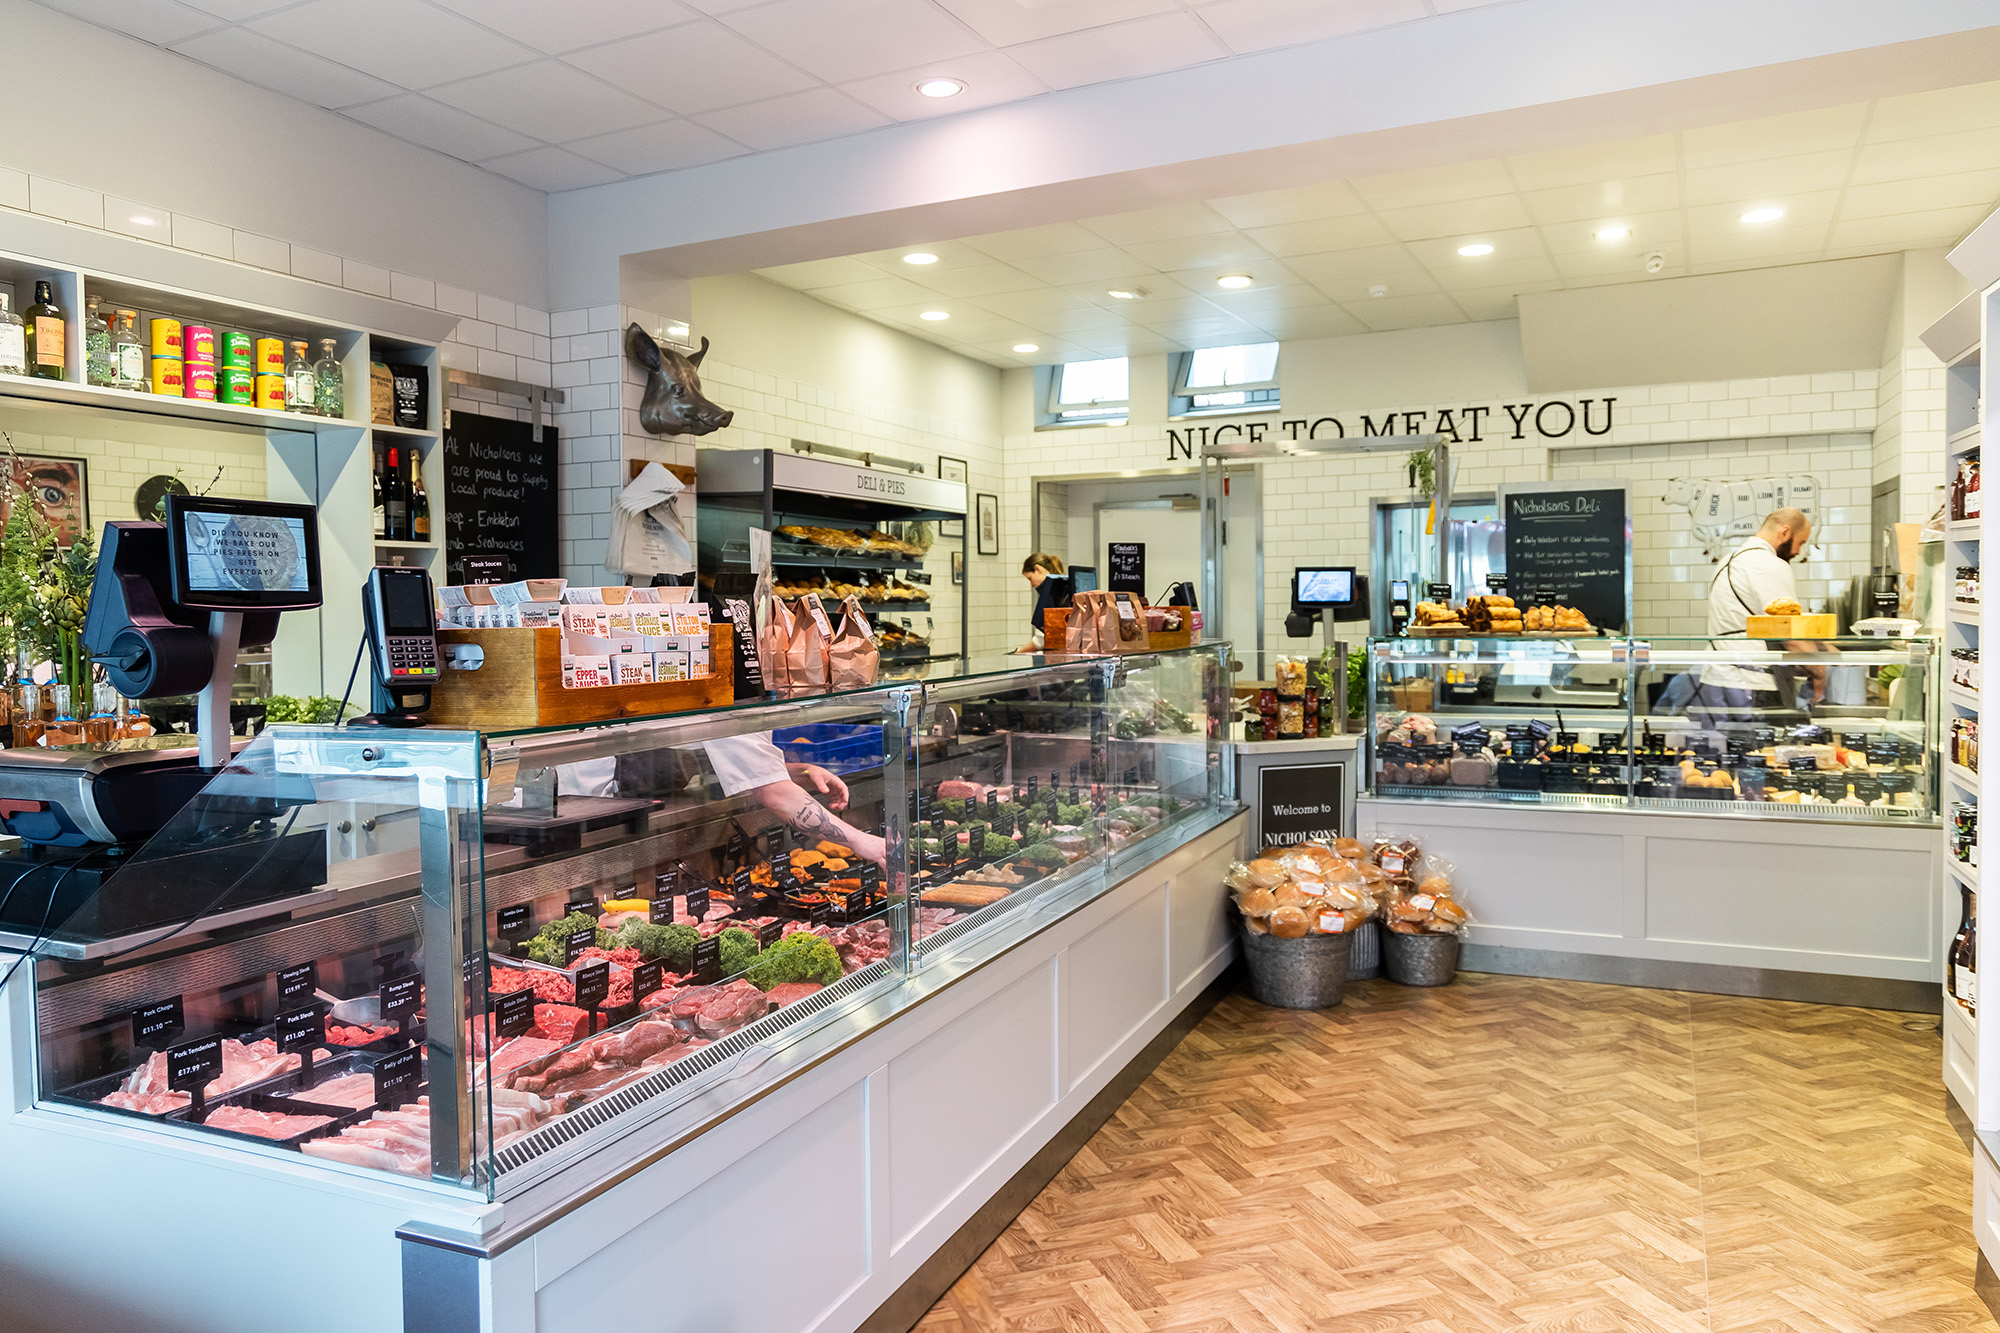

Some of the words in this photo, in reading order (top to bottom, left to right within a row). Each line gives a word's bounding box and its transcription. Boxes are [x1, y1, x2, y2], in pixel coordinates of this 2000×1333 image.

[1166, 422, 1268, 461] NICE
[1283, 417, 1344, 440] TO
[1360, 406, 1490, 443] MEAT
[1503, 398, 1617, 440] YOU
[445, 436, 460, 456] At
[469, 442, 522, 462] Nicholsons
[451, 464, 470, 477] are
[476, 468, 502, 482] proud
[506, 469, 518, 482] to
[857, 474, 877, 490] DELI
[879, 478, 886, 492] &
[888, 480, 905, 494] PIES
[484, 486, 525, 502] produce!
[1512, 499, 1570, 515] Nicholsons
[1575, 497, 1601, 512] Deli
[1710, 493, 1720, 516] CHUCK
[446, 512, 464, 530] eef
[478, 510, 520, 528] Embleton
[476, 534, 524, 550] Seahouses
[520, 616, 548, 628] MUSHROOM
[572, 618, 597, 628] STEAK
[635, 616, 660, 626] BEARNAISE
[676, 616, 700, 626] STILTON
[636, 626, 662, 636] SAUCE
[678, 626, 700, 636] SAUCE
[576, 670, 598, 680] EPPER
[620, 668, 642, 678] STEAK
[658, 665, 678, 675] BEARNAISE
[1272, 804, 1320, 816] Welcome
[1321, 804, 1332, 814] to
[1265, 828, 1338, 846] NICHOLSONS
[283, 970, 299, 980] Stewing
[300, 966, 310, 974] Steak
[284, 984, 300, 994] £19.99
[402, 980, 414, 988] Steak
[504, 1000, 516, 1008] Sirloin
[516, 996, 528, 1004] Steak
[144, 1009, 156, 1017] Pork
[156, 1004, 174, 1013] Chops
[288, 1014, 300, 1024] Pork
[300, 1010, 314, 1020] Steak
[503, 1014, 518, 1025] £42.99
[142, 1022, 164, 1034] £11.10
[285, 1030, 306, 1042] £11.00
[174, 1050, 188, 1058] Pork
[188, 1042, 217, 1054] Tenderloin
[384, 1061, 396, 1070] Belly
[403, 1054, 414, 1062] Pork
[178, 1064, 200, 1076] £17.99
[383, 1076, 403, 1088] £11.10
